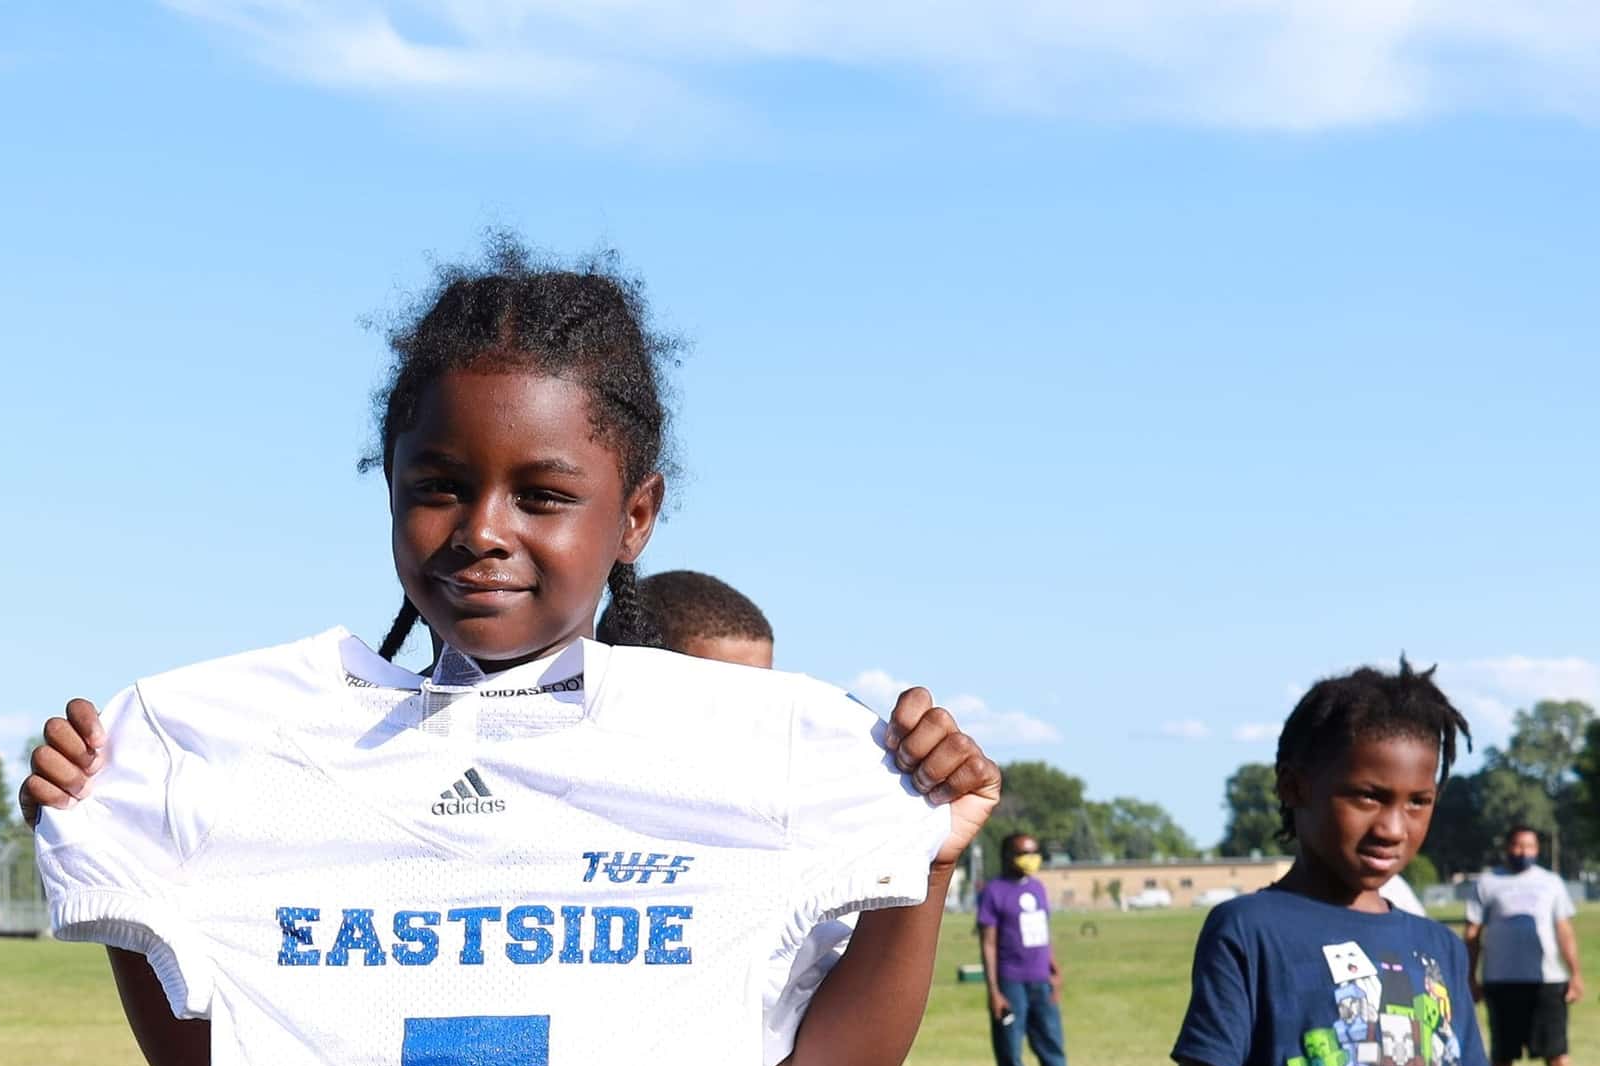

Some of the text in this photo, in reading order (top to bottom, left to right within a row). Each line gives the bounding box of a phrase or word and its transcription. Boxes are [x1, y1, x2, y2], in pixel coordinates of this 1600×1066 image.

[431, 797, 506, 816] adidas
[582, 851, 696, 884] TUFF
[276, 905, 693, 966] EASTSIDE
